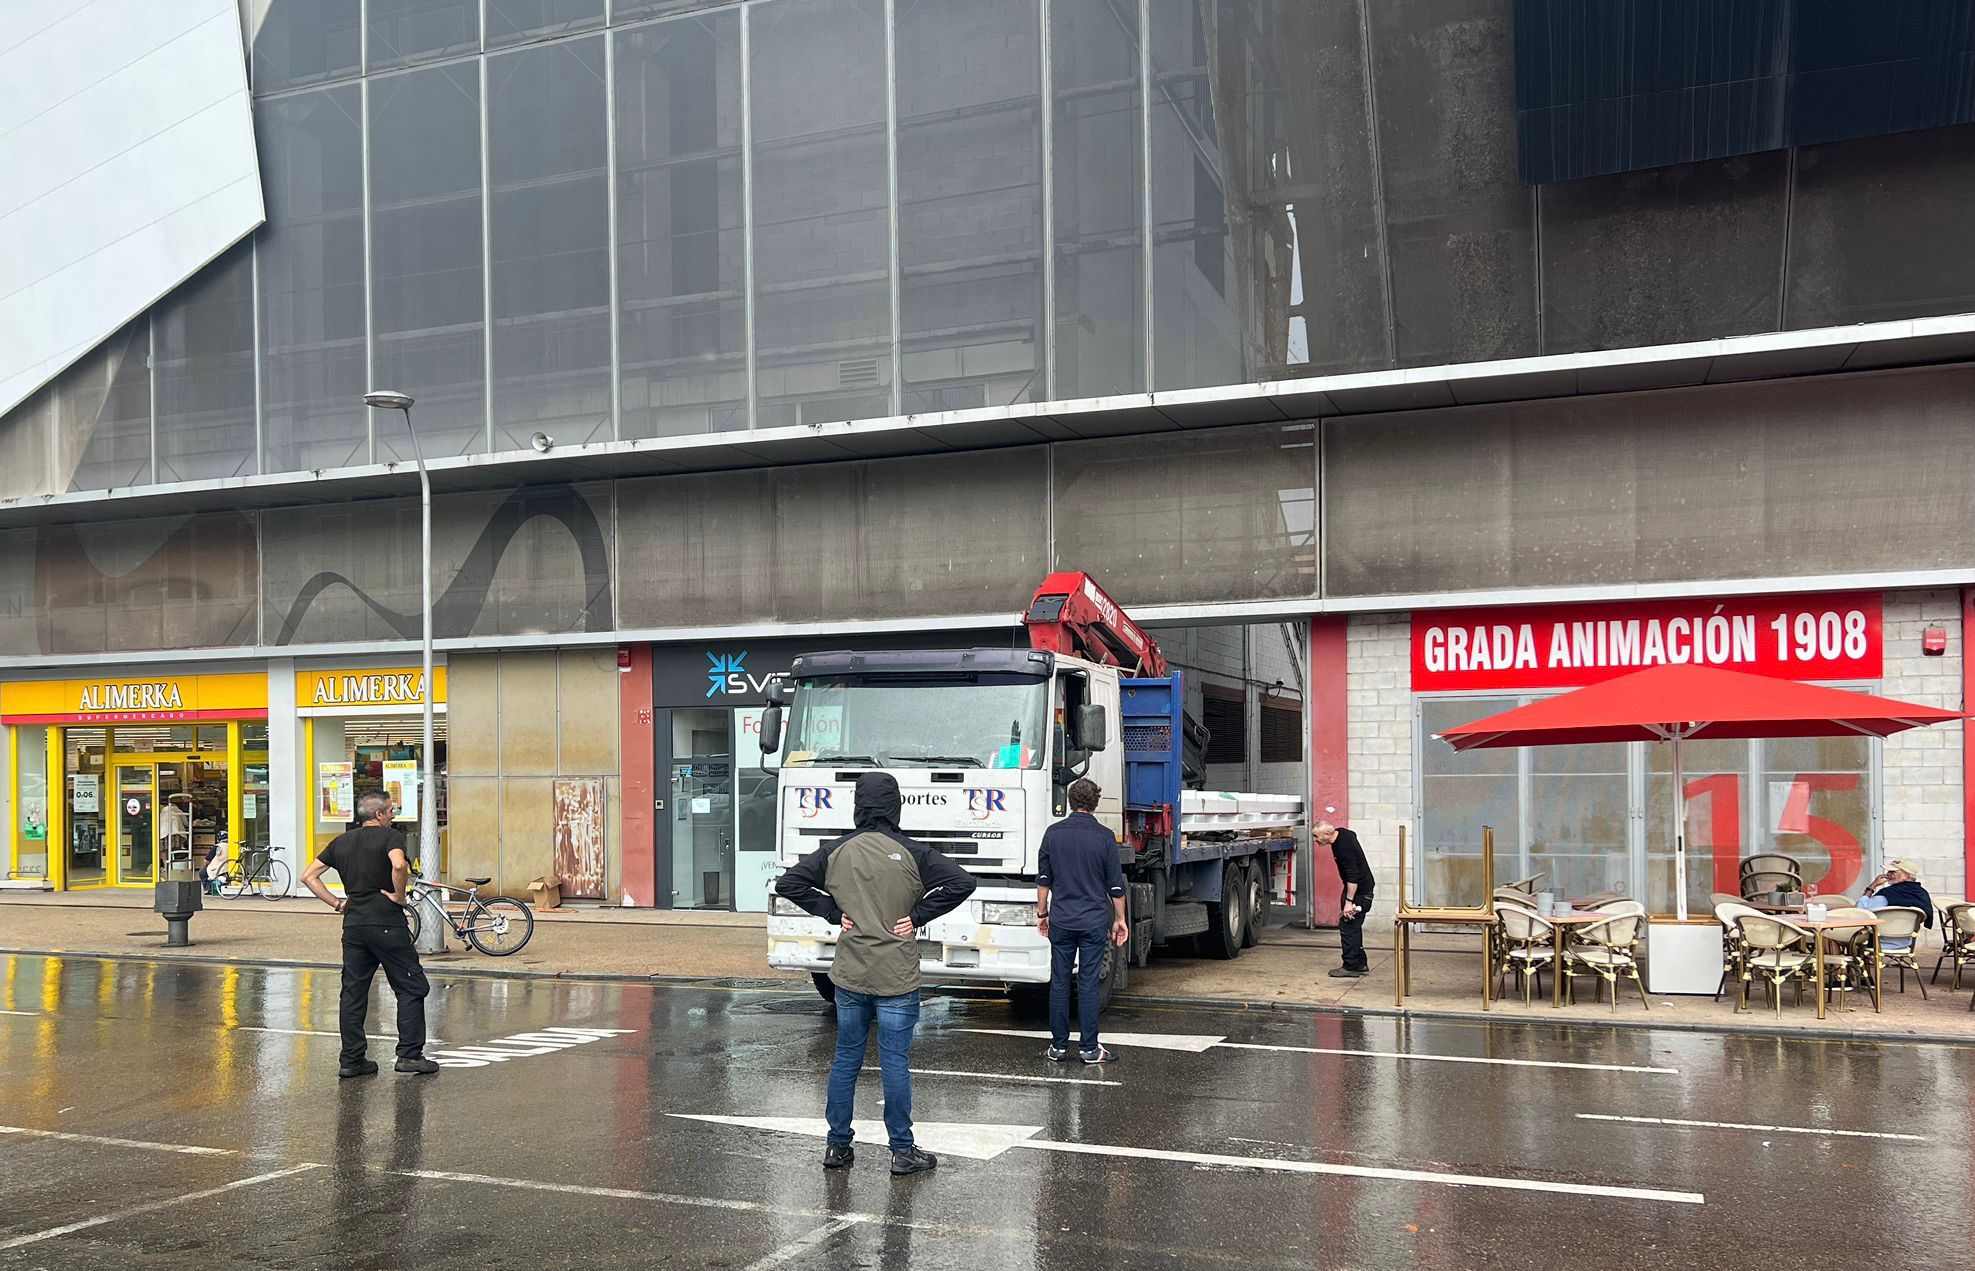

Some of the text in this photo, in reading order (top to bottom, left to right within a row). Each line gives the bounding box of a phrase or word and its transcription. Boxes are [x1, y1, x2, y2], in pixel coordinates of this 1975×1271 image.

[1423, 605, 1867, 672] GRADA ANIMACIÓN 1908
[78, 713, 185, 721] SUPERMERCADO
[79, 683, 183, 710] ALIMERKA
[1683, 773, 1862, 899] 15
